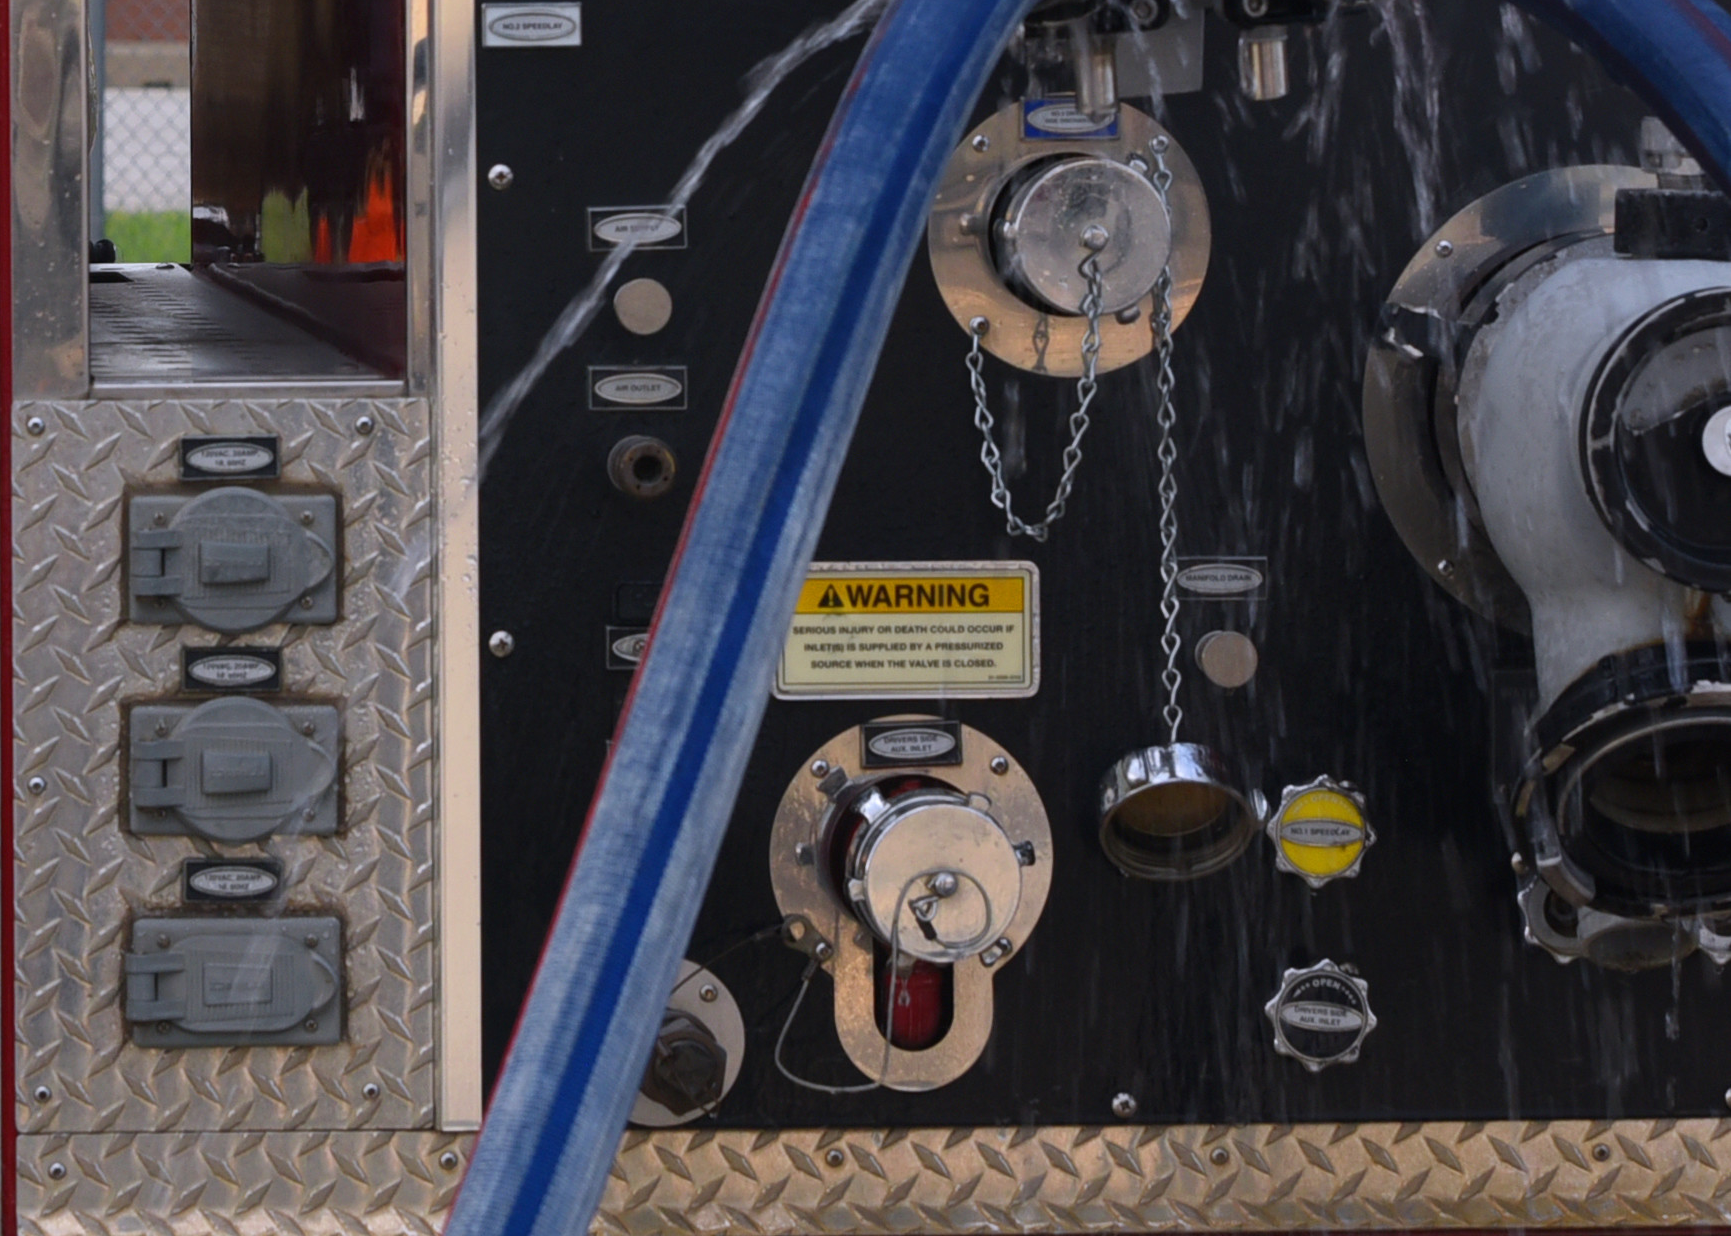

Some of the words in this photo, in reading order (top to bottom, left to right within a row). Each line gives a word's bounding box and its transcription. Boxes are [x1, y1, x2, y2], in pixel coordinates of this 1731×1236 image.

[522, 22, 563, 30] SPEEDLAY
[1185, 574, 1226, 582] MANIFOLD
[1227, 574, 1252, 582] DRAIN
[846, 583, 990, 608] WARNING
[793, 625, 837, 634] SERIOUS
[838, 625, 875, 634] INJURY
[877, 625, 892, 634] OR
[894, 625, 928, 634] DEATH
[930, 625, 965, 634] COULD
[967, 625, 1004, 634] OCCUR
[1006, 625, 1014, 634] IF
[804, 643, 845, 653] INLET(S)
[846, 643, 856, 652] IS
[858, 643, 907, 652] SUPPLIED
[909, 643, 923, 652] BY
[925, 643, 932, 652] A
[934, 643, 1004, 652] PRESSURIZED
[811, 660, 853, 669] SOURCE
[855, 660, 885, 669] WHEN
[887, 660, 907, 669] THE
[909, 660, 940, 669] VALVE
[942, 660, 952, 669] IS
[954, 660, 997, 669] CLOSED.
[883, 735, 917, 744] DRIVERS
[920, 735, 938, 743] SIDE
[909, 744, 932, 752] INLET
[1312, 978, 1341, 991] OPEN
[1294, 1006, 1328, 1016] DRIVERS
[1329, 1008, 1347, 1017] SIDE
[1318, 1017, 1341, 1026] INLET
